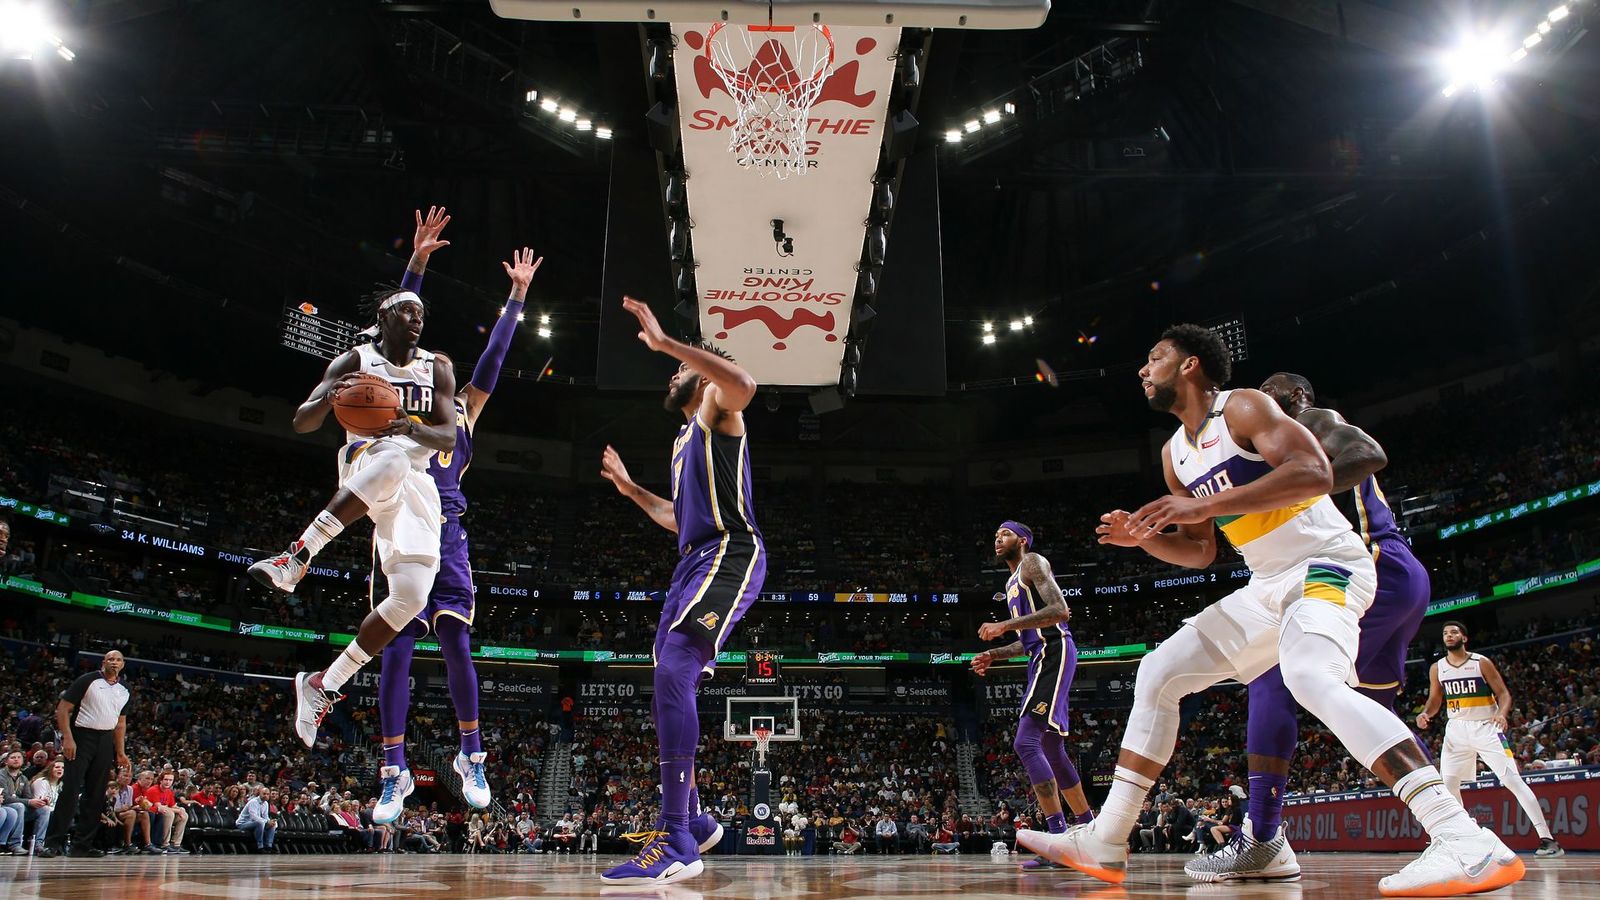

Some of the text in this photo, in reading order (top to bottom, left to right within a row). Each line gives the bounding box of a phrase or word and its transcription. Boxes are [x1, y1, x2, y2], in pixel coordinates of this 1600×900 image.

[688, 109, 875, 134] SMOTHIE
[744, 267, 812, 275] CENTER
[704, 289, 846, 306] SMOOTHIE
[395, 386, 433, 412] OLA
[121, 530, 350, 580] 34 K. WILLIAMS POINTS OUNDS 4
[6, 579, 67, 599] OBEY YOUR THIRST
[1095, 585, 1128, 595] POINTS
[1133, 583, 1140, 592] 3
[1154, 574, 1205, 588] REBOUNDS
[1210, 574, 1216, 582] 2
[1516, 576, 1539, 596] Sprite
[1544, 575, 1563, 584] OBEY
[490, 586, 528, 597] BLOCKS
[533, 590, 539, 598] 0
[594, 592, 600, 600] 5
[614, 592, 620, 600] 3
[808, 593, 819, 601] 59
[913, 594, 917, 602] 1
[932, 594, 938, 602] 5
[1427, 594, 1476, 613] BEY YOUR THIRST
[107, 601, 198, 622] Sprite OBEY YOUR THIRST
[239, 624, 262, 635] Sprite
[285, 630, 303, 638] YOUR
[303, 632, 325, 640] THIRST
[755, 653, 774, 662] 8:34
[819, 653, 838, 663] Sprite
[931, 653, 951, 664] Sprite
[758, 661, 772, 676] 15
[353, 672, 382, 688] LET
[497, 682, 543, 694] SeatGeek
[581, 683, 635, 697] LET'S GO
[703, 686, 747, 695] SeatGeek
[784, 685, 843, 699] LET'S GO
[909, 687, 947, 696] SeatGeek
[985, 684, 1024, 699] LET'S
[1444, 680, 1477, 696] NOLA
[583, 707, 619, 716] LET'S GO
[1448, 700, 1460, 713] 34
[1287, 814, 1311, 841] CAS
[1315, 813, 1338, 840] OIL
[1366, 808, 1422, 839] LUCAS
